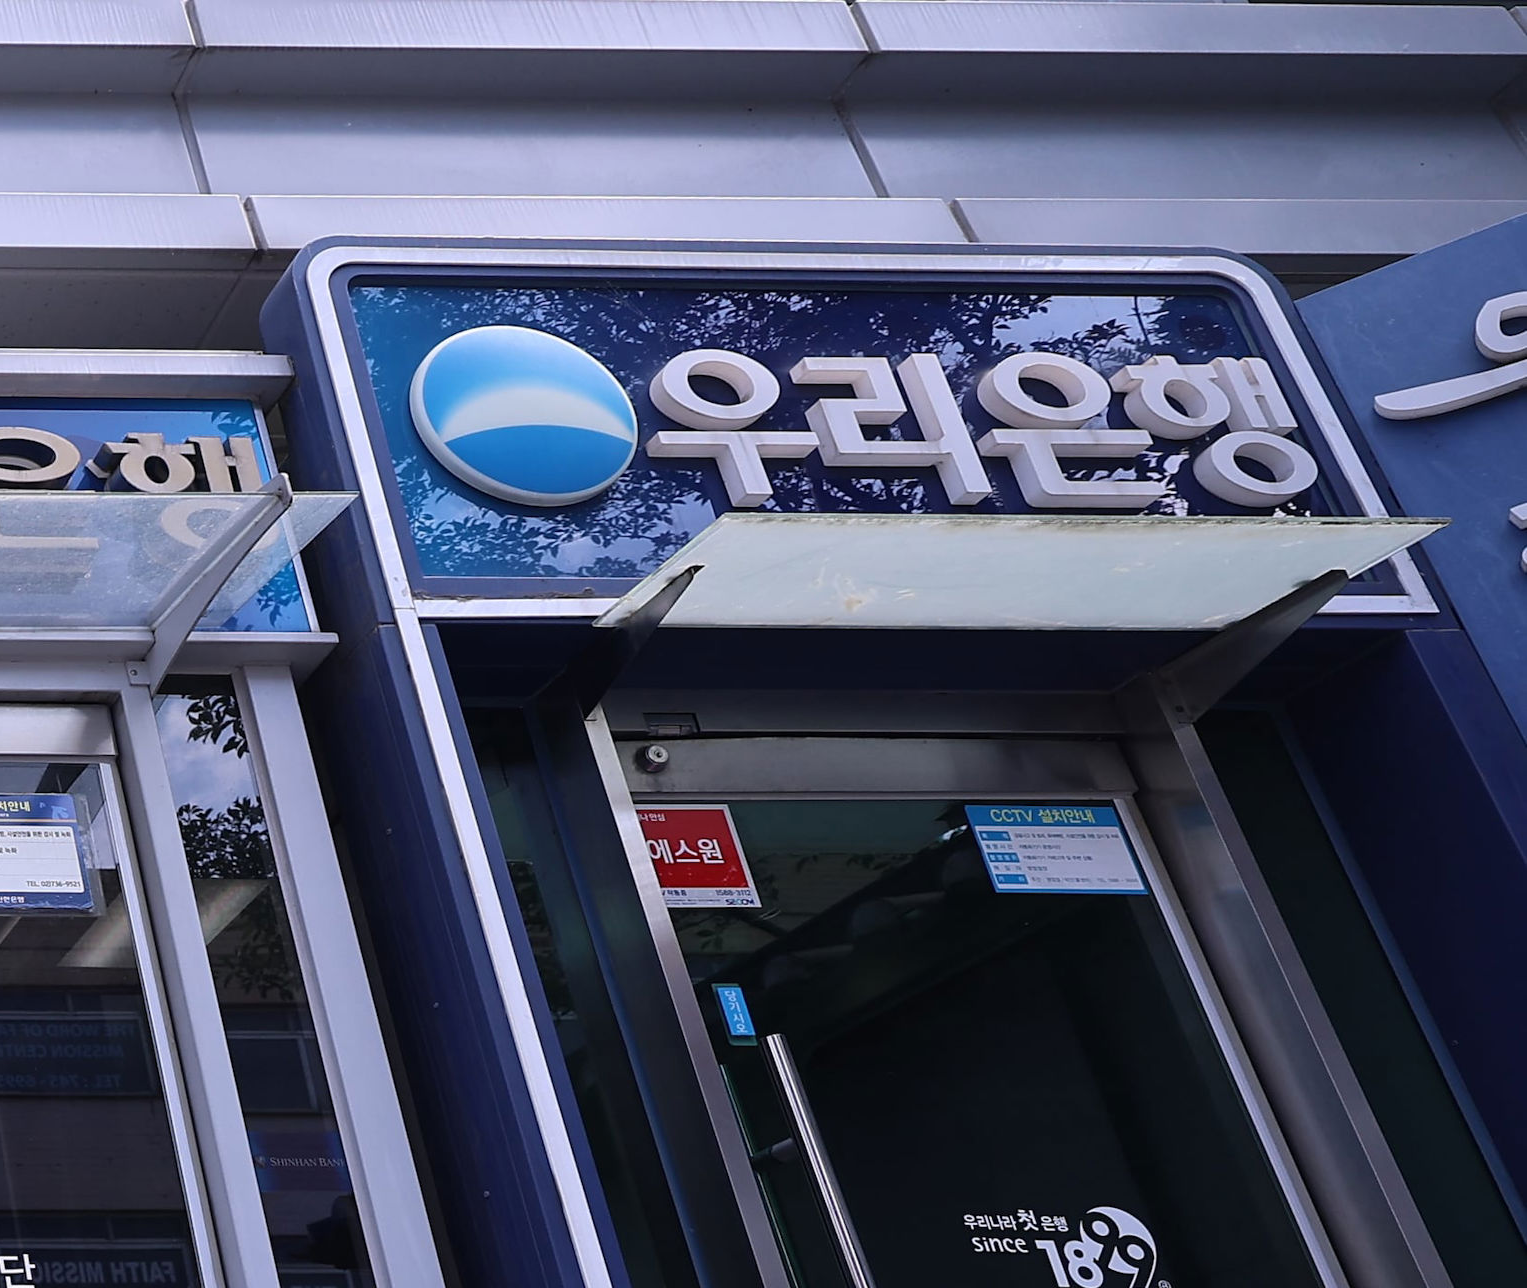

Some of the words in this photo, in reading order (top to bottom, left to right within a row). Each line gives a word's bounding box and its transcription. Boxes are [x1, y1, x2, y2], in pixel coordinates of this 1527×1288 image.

[646, 349, 1318, 508] 우리은행
[990, 809, 1033, 822] CCTV
[1038, 809, 1096, 824] 설치안내
[647, 839, 725, 864] 에스원
[724, 990, 748, 1033] 당기시오
[963, 1213, 1017, 1232] 우리나라
[1017, 1209, 1039, 1232] 첫
[1040, 1215, 1070, 1233] 은행
[971, 1236, 1029, 1253] since
